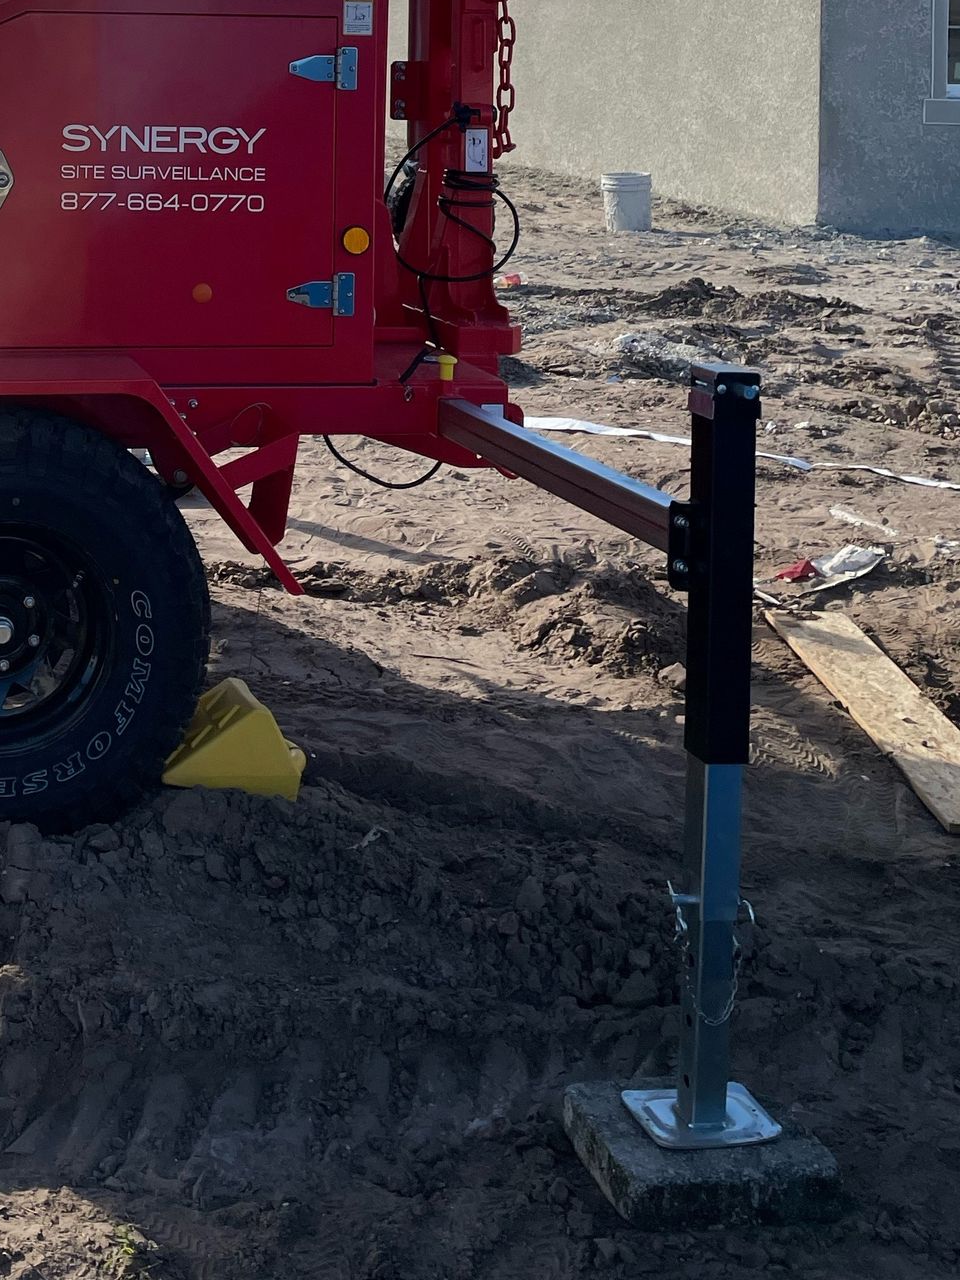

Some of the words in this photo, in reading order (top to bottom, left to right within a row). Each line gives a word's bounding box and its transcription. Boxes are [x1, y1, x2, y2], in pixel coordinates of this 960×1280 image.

[61, 124, 266, 153] SYNERGY
[60, 165, 104, 179] SITE
[111, 165, 265, 181] SURVEILLANCE
[60, 192, 265, 212] 877-664-0770
